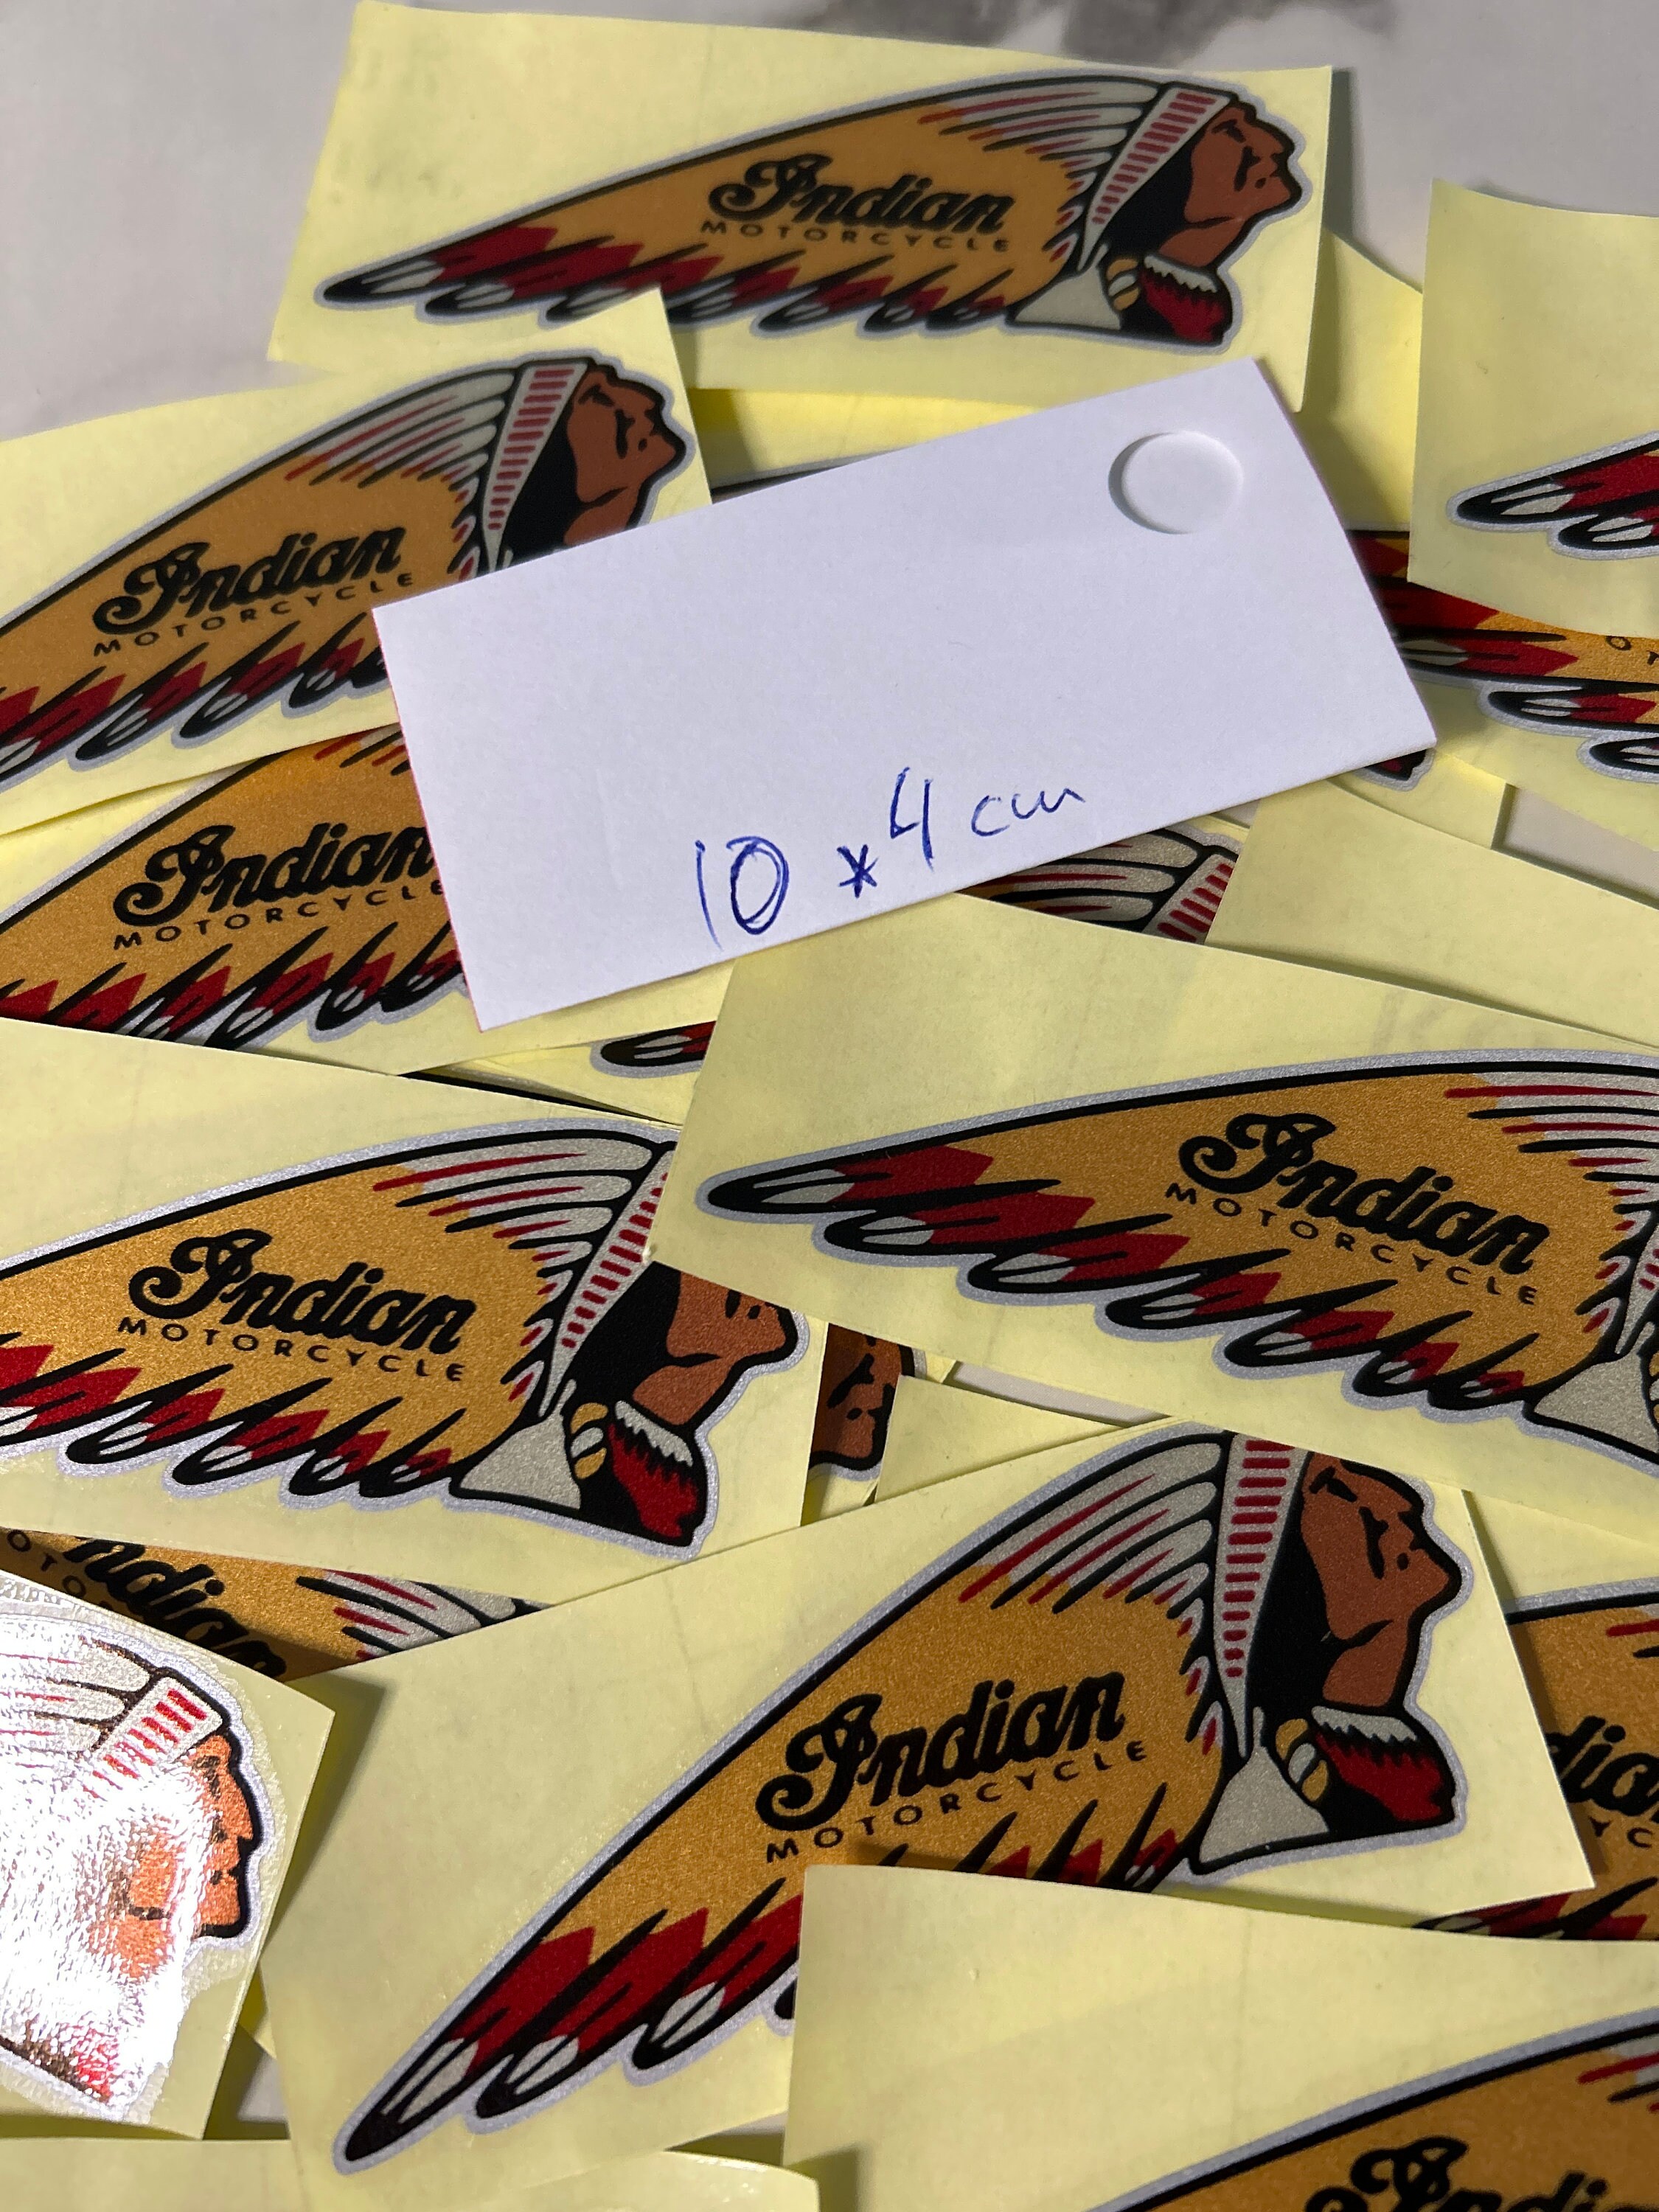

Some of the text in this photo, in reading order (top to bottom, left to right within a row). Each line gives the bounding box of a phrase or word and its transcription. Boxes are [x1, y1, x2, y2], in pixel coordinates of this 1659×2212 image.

[700, 219, 1009, 252] MOTORCYCLE
[709, 153, 1016, 234] Indian
[92, 526, 407, 635] Indian
[93, 572, 413, 657] MOTORCYCLE
[113, 822, 435, 927] Indian
[695, 835, 790, 951] 10
[890, 766, 934, 872] 4
[970, 787, 1086, 837] cm
[114, 879, 443, 950] MOTORCYCLE
[1165, 1183, 1537, 1305] MOTORCYCLE
[1179, 1112, 1550, 1275] Indian
[128, 1228, 477, 1354] Indian
[118, 1317, 466, 1382] MOTORCYCLE
[755, 1671, 1127, 1831] Indian
[767, 1740, 1147, 1863] MOTORCYCLE
